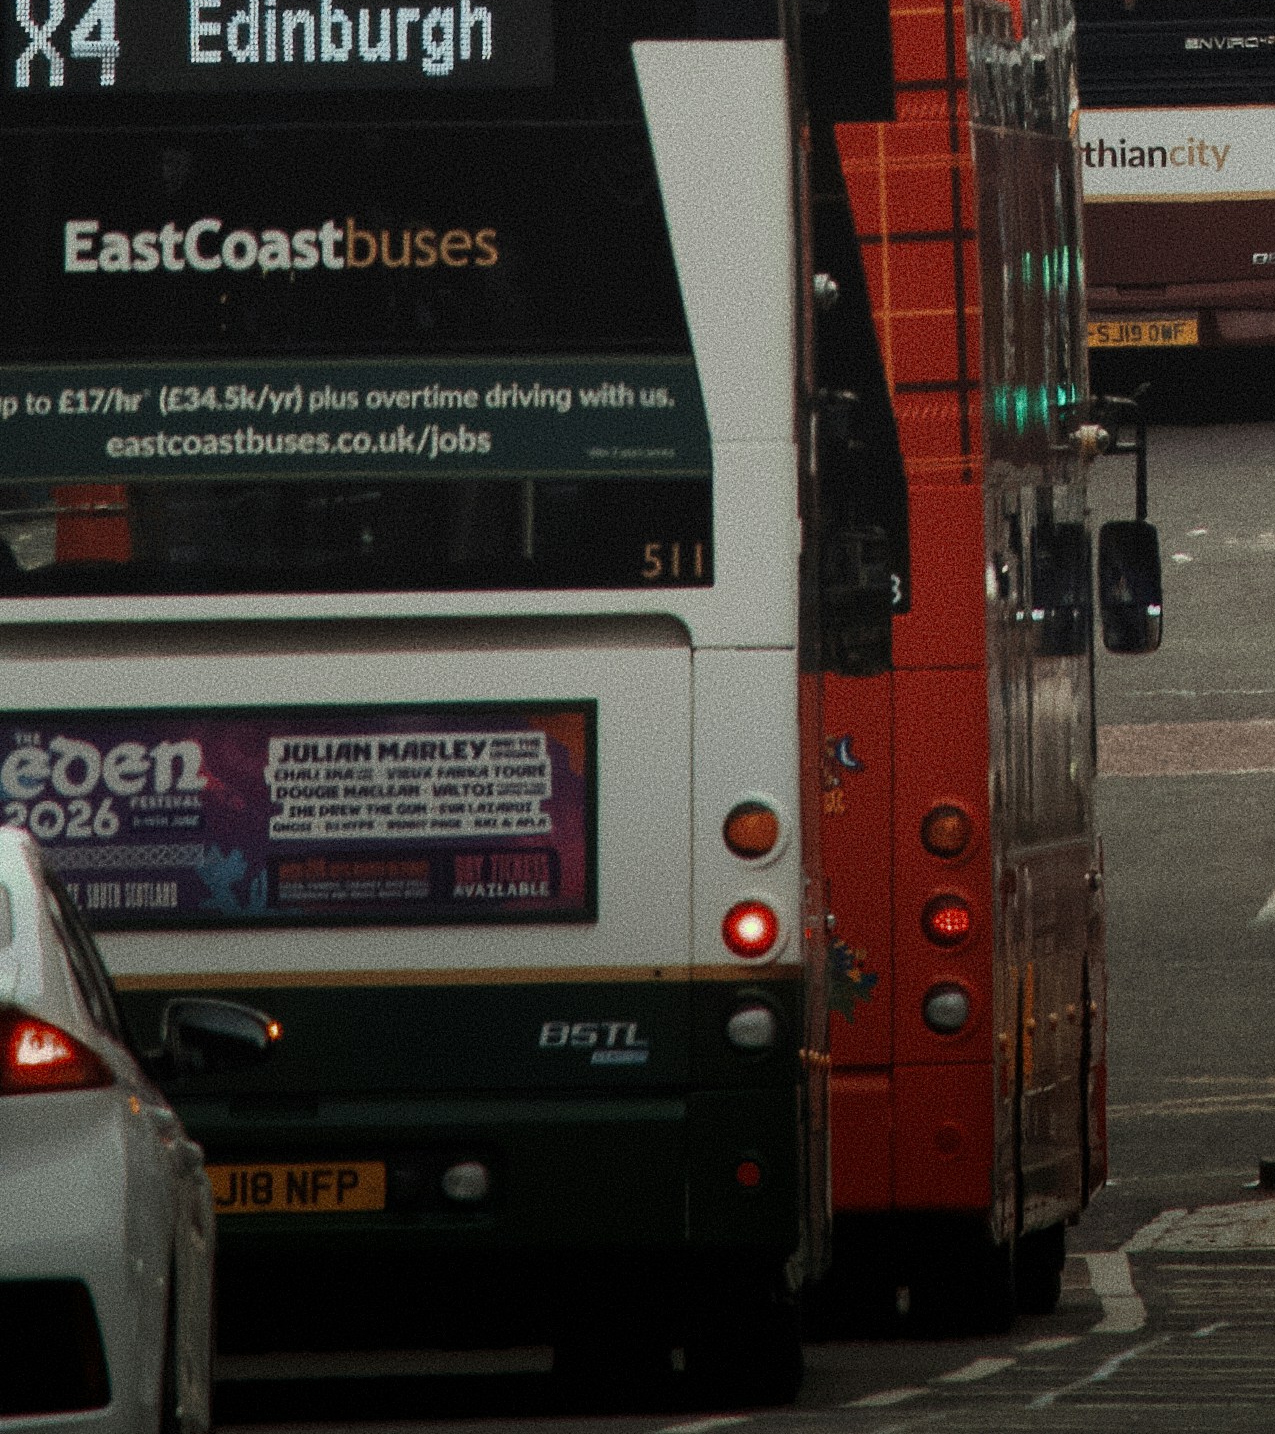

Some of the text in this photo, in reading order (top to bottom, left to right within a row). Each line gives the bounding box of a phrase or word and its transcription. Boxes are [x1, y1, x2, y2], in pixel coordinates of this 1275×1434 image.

[1085, 137, 1232, 174] thiancity
[63, 216, 500, 274] EastCoastbuses
[0, 394, 19, 421] p
[24, 391, 52, 417] to
[158, 383, 304, 418] (£34.5k/yr)
[308, 385, 360, 416] plus
[365, 381, 481, 411] overtime
[484, 380, 574, 416] driving
[578, 381, 636, 410] with
[639, 386, 677, 409] us.
[104, 421, 493, 462] eastcoastbuses.co.uk/jobs
[641, 542, 704, 580] 511
[1, 734, 208, 798] eden
[278, 739, 487, 763] JULIAN MARLEY
[276, 784, 339, 798] DOUGIE
[3, 797, 120, 840] 2026
[452, 881, 550, 898] AVAILABLE
[215, 1169, 360, 1207] J18 NFP
